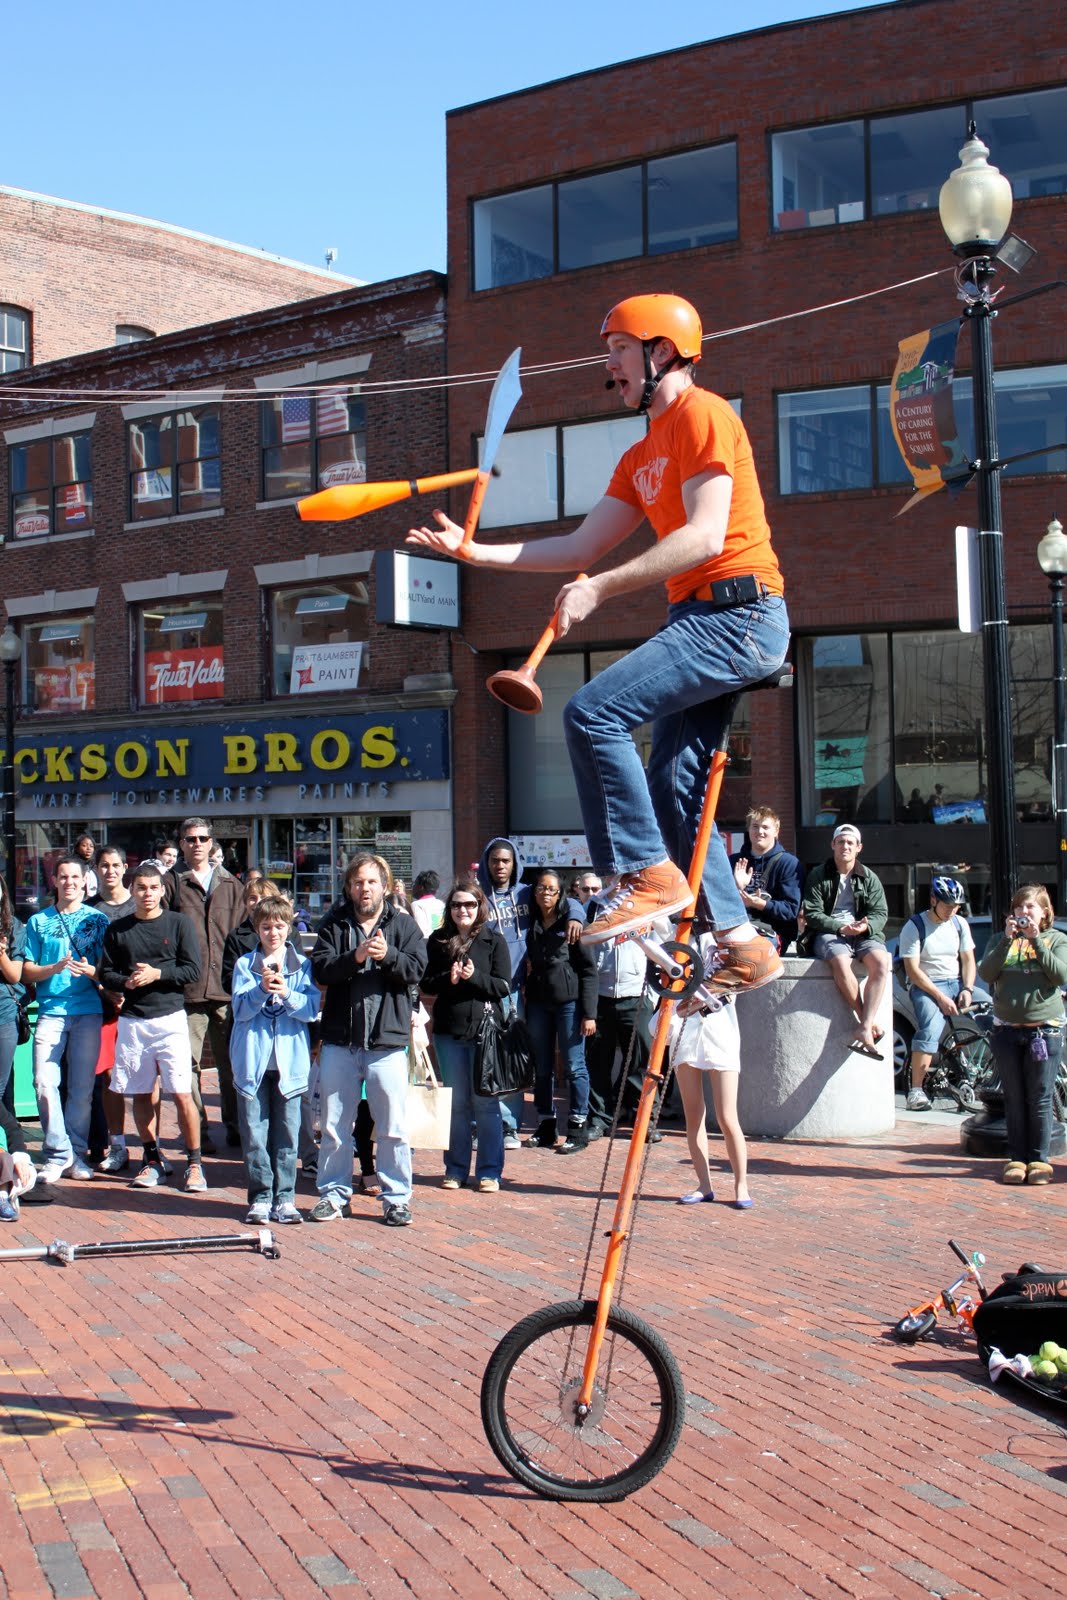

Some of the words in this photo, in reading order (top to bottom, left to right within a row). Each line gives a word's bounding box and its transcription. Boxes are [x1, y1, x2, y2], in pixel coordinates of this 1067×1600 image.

[896, 409, 901, 418] A
[901, 405, 932, 417] CENTURY
[898, 421, 906, 430] OF
[907, 417, 934, 429] CARING
[904, 432, 919, 442] FOR
[918, 431, 932, 440] THE
[909, 443, 935, 455] SQUARE
[437, 597, 456, 607] MAIN
[323, 650, 360, 661] LAMBERT
[318, 667, 356, 681] PAINT
[0, 739, 190, 785] CKSON
[223, 726, 408, 774] BROS.
[111, 786, 265, 806] HOUSEWARES
[299, 782, 389, 800] PAINTS
